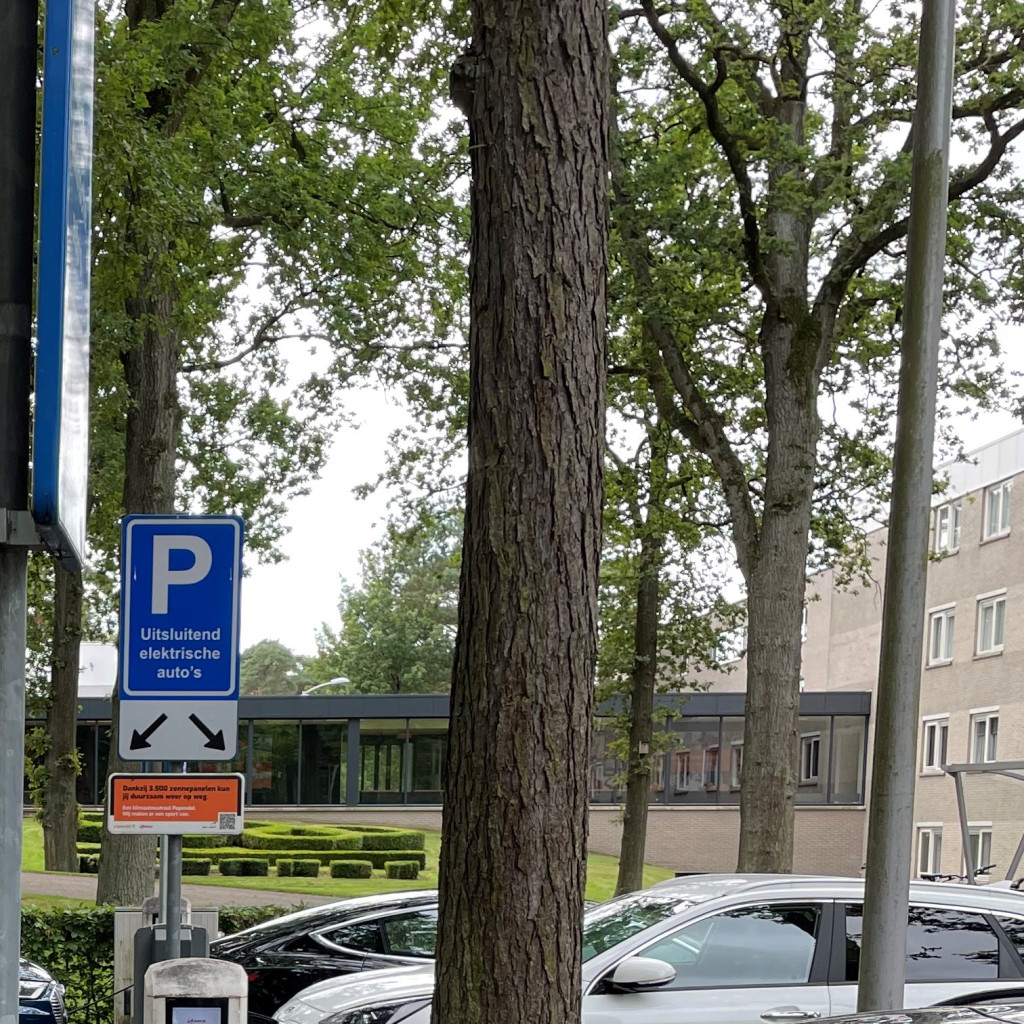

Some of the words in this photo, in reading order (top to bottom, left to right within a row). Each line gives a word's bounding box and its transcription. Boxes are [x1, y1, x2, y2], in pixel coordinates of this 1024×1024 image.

[151, 534, 213, 615] P
[140, 627, 221, 641] Uitsluitend
[139, 646, 221, 660] elektrische
[156, 666, 202, 679] auto's
[122, 785, 148, 793] Dankzij
[169, 785, 216, 793] zonnepanelen
